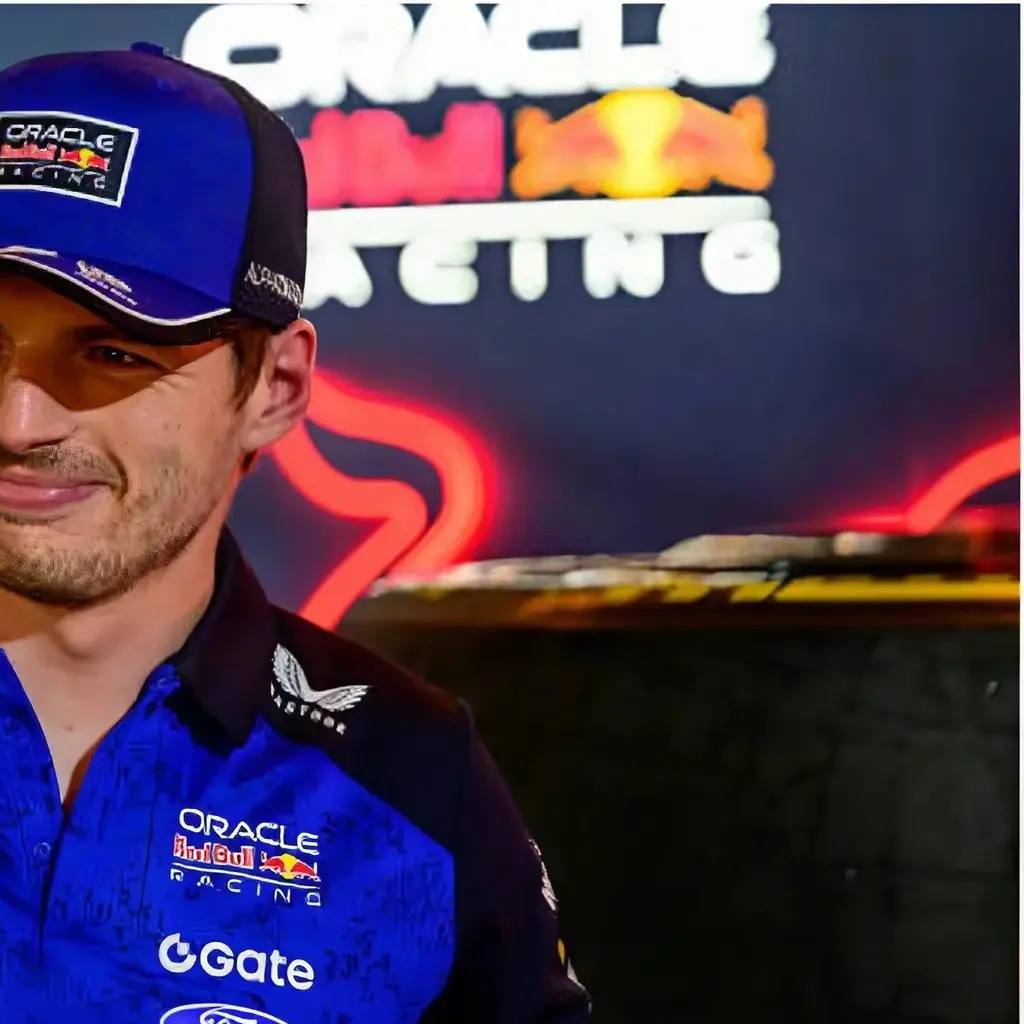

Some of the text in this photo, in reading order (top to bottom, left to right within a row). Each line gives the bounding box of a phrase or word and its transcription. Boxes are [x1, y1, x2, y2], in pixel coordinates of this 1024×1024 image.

[182, 4, 776, 106] ORACLE
[6, 124, 116, 153] ORACLE
[301, 220, 780, 307] ACING
[179, 808, 320, 856] ORACLE
[199, 940, 315, 991] Gate
